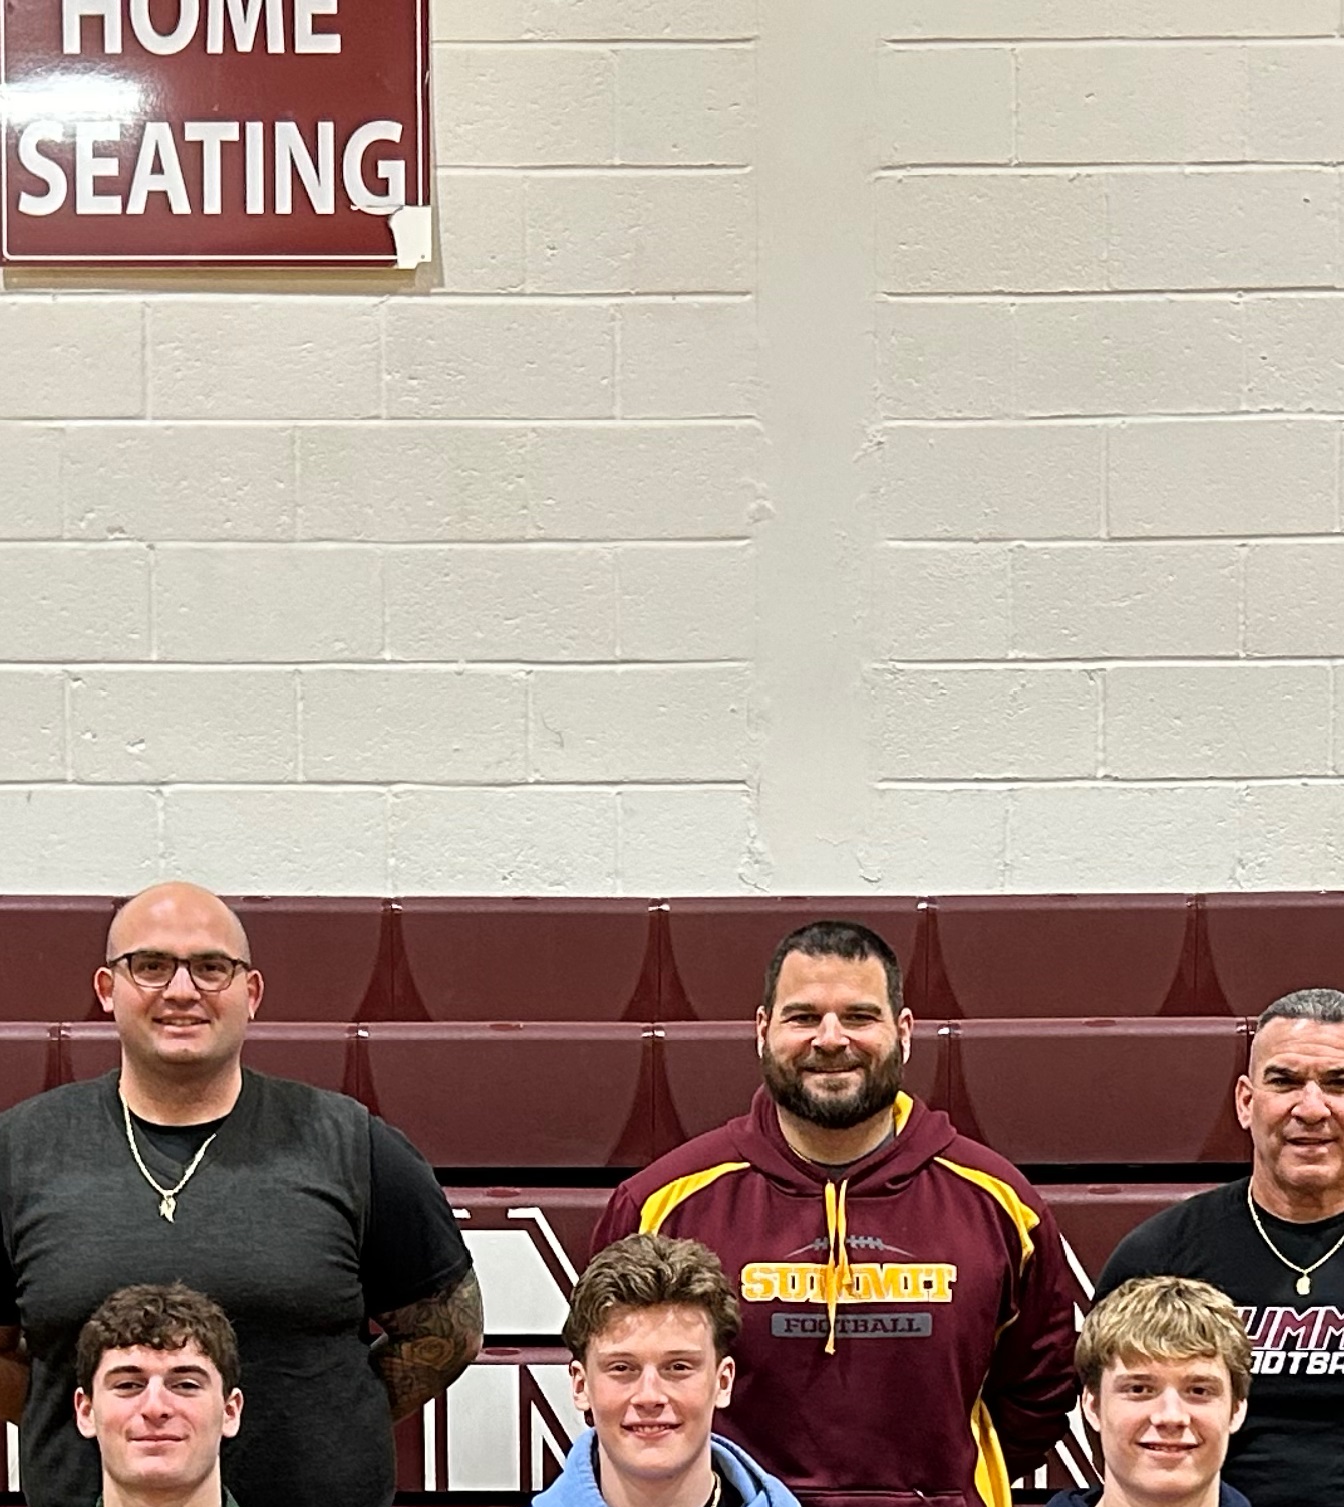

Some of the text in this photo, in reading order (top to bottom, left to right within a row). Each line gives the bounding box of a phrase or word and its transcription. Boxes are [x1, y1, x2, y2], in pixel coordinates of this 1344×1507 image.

[62, 0, 342, 55] HOME
[18, 120, 406, 216] SEATING
[784, 1317, 922, 1334] FOOTBALL
